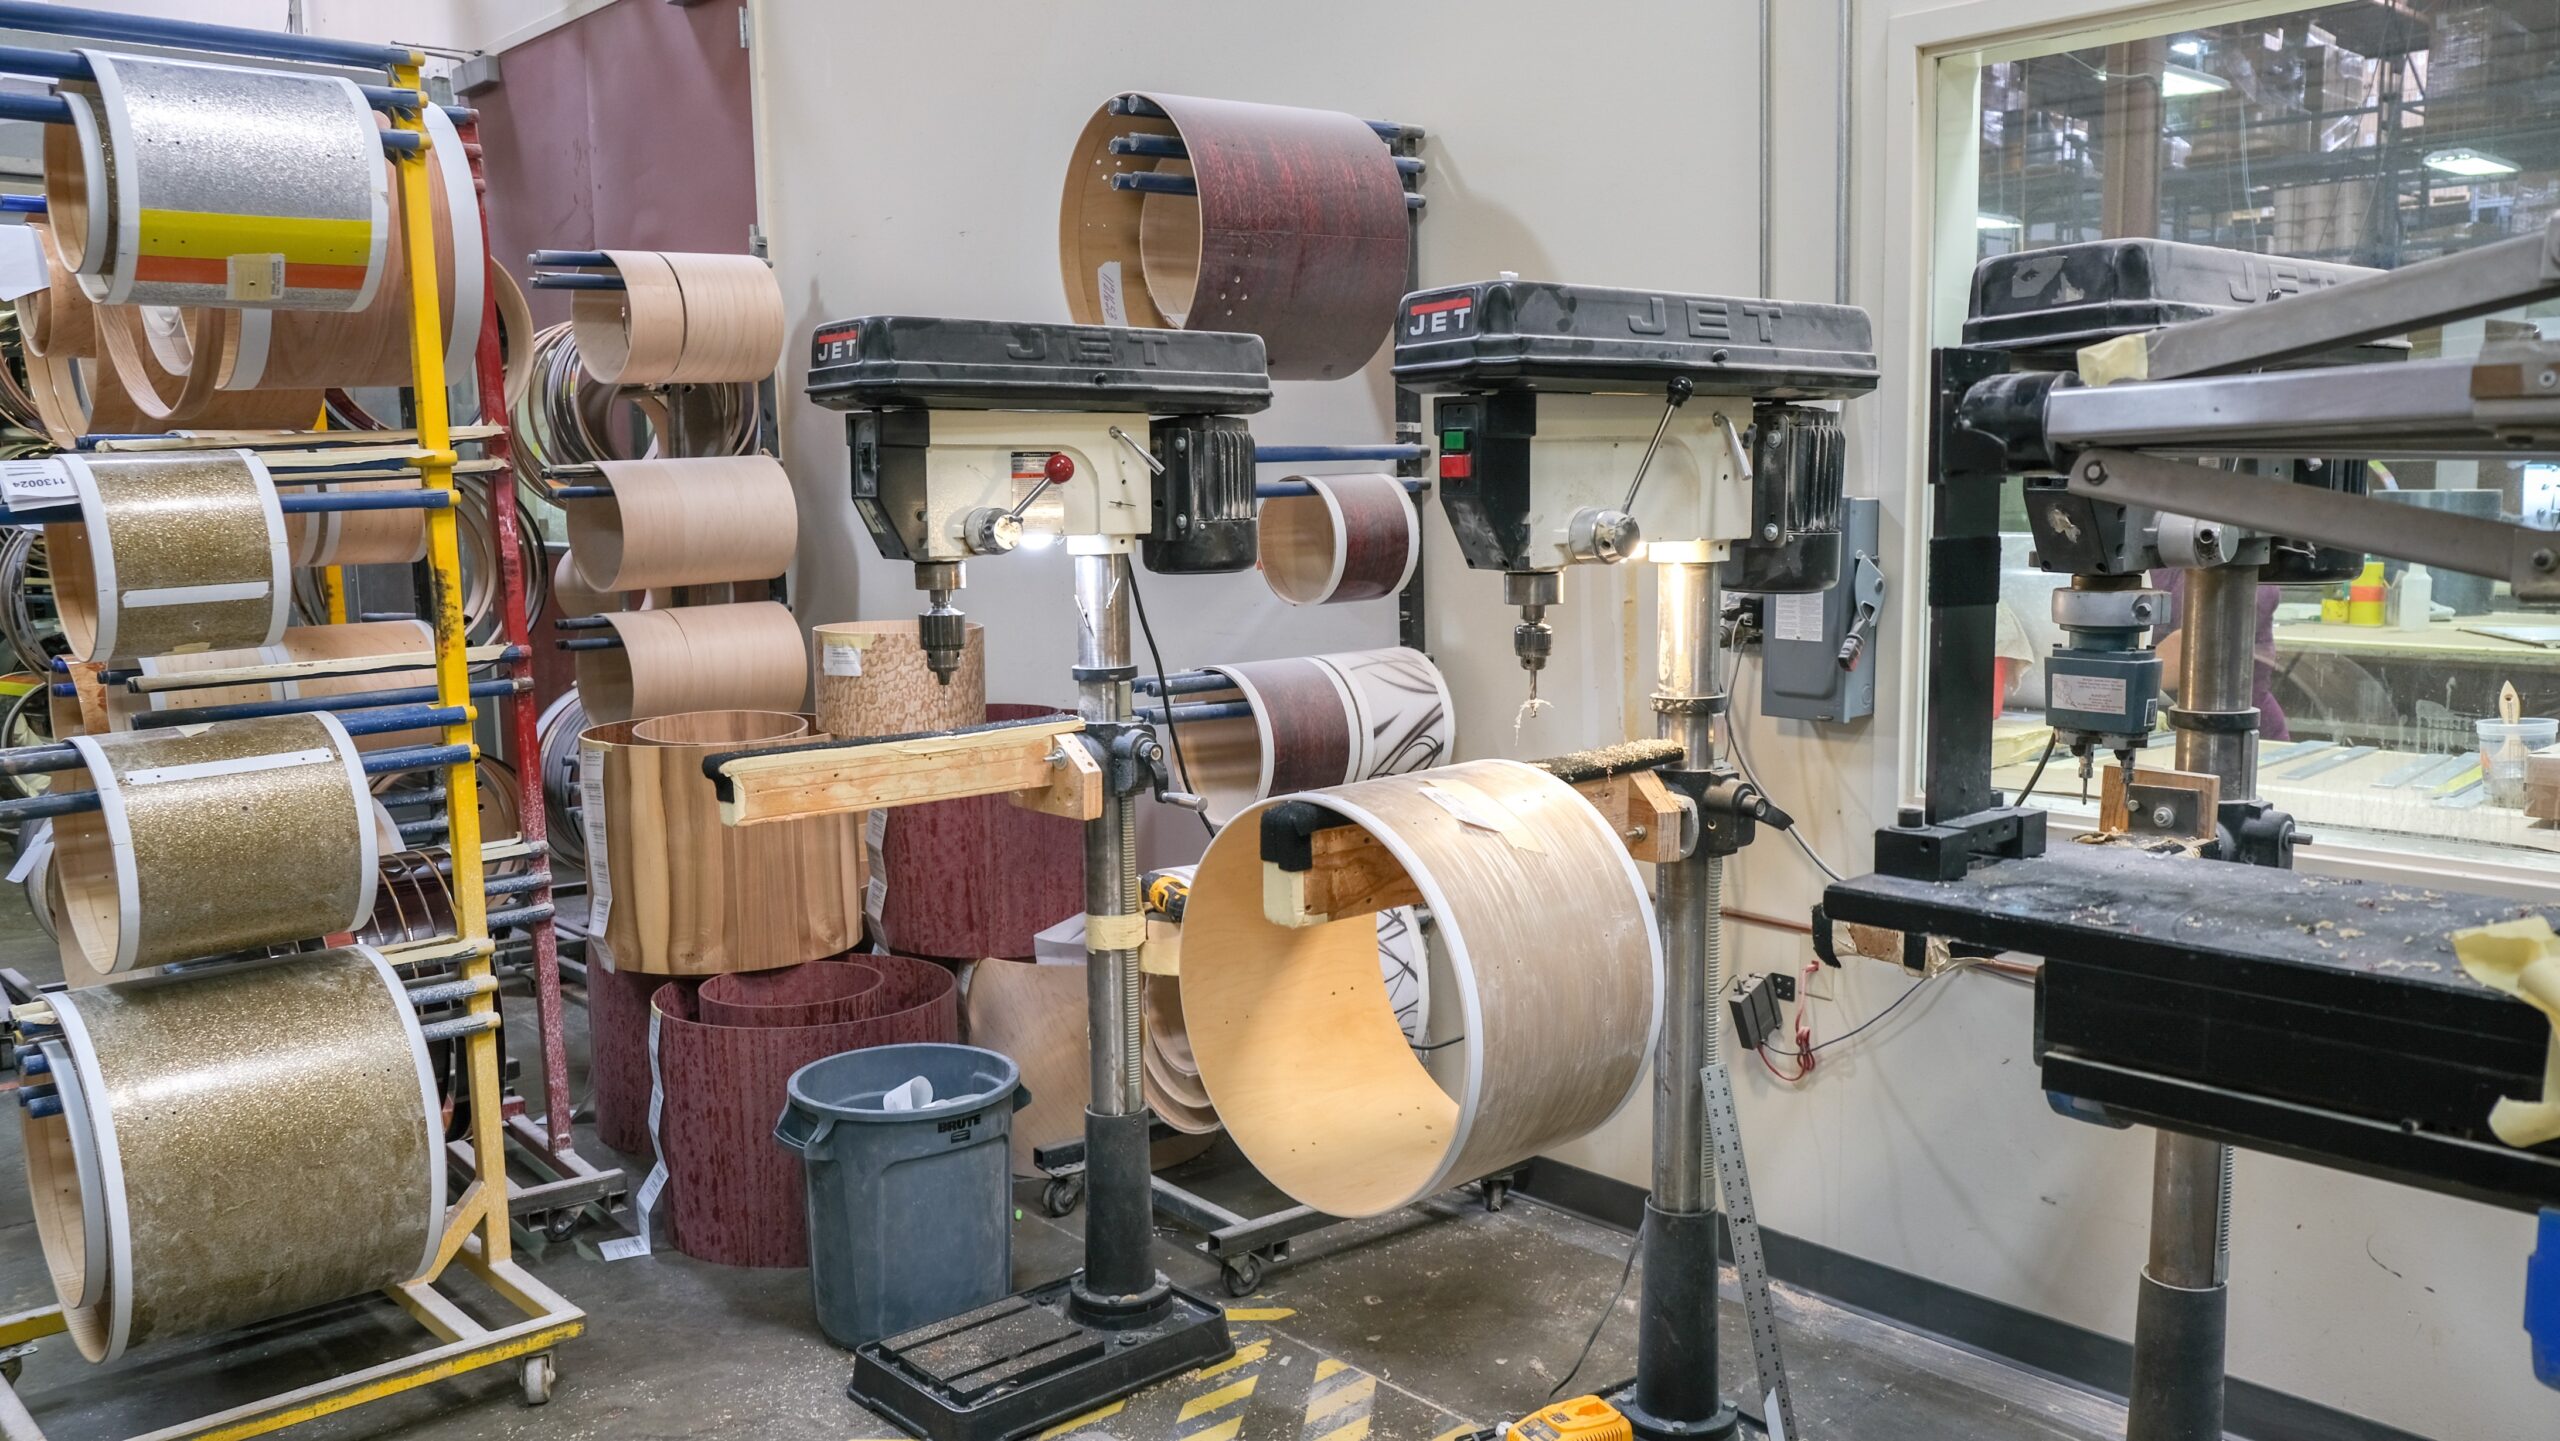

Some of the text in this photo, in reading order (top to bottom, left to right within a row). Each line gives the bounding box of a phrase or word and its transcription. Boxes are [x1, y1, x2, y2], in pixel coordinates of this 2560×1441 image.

[1410, 307, 1471, 336] JET
[1628, 297, 1782, 343] JET
[817, 339, 857, 361] JET
[1006, 328, 1168, 366] JET
[12, 478, 66, 488] 1130024
[937, 1113, 981, 1133] BRUTE
